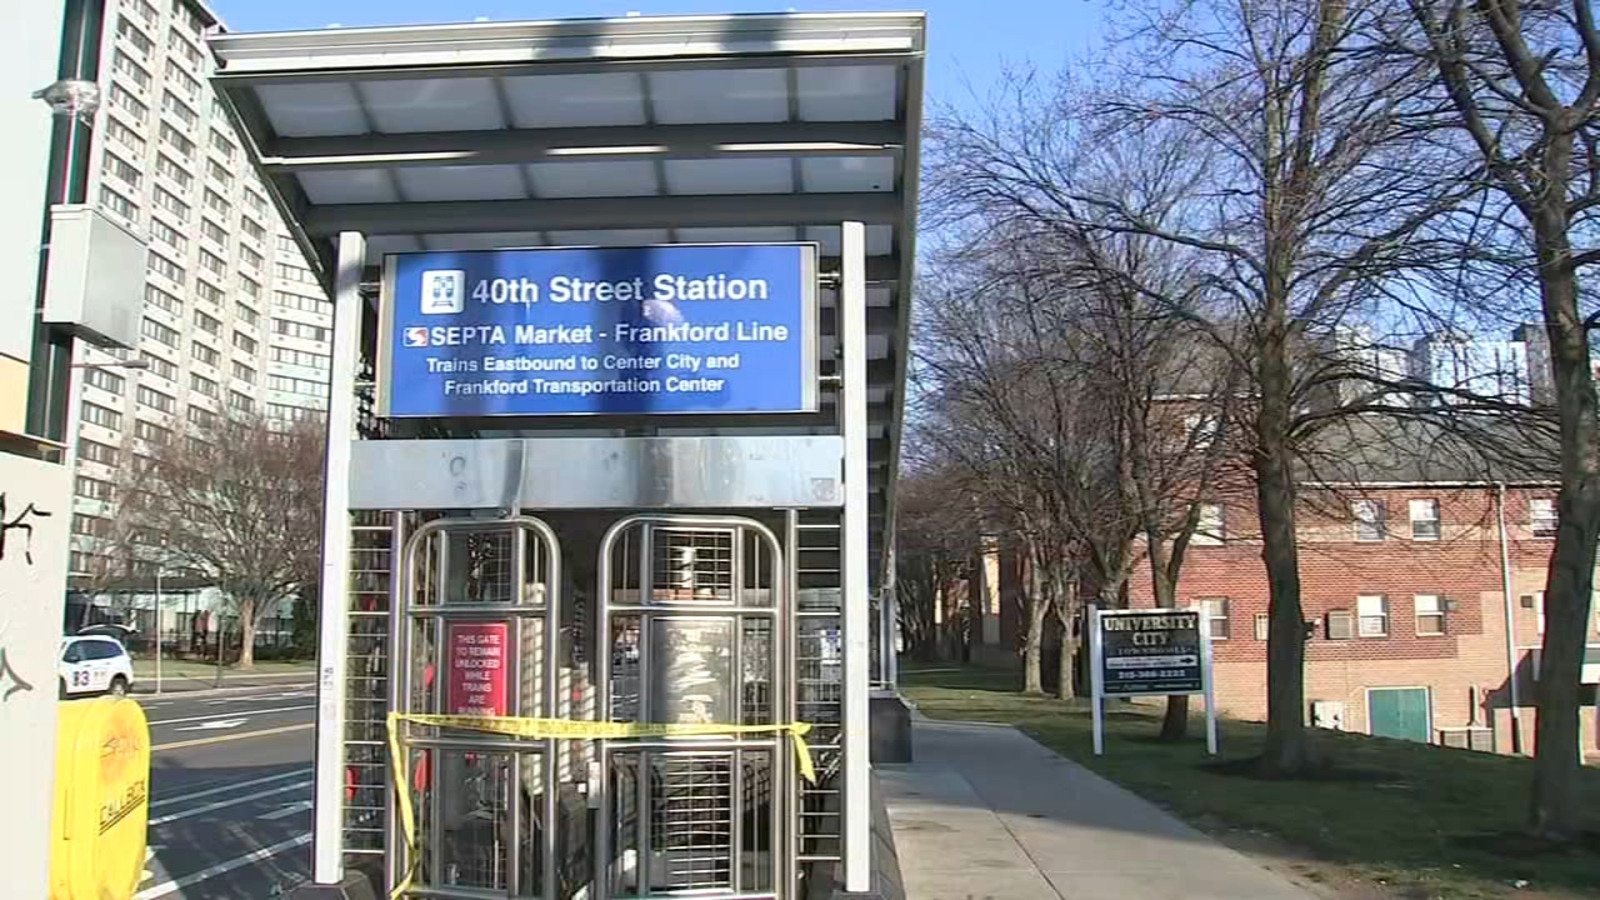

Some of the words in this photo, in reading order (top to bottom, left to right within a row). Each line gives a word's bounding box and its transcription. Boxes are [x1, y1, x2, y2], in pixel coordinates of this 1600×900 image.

[472, 277, 539, 304] 40th
[549, 276, 643, 302] Street
[653, 273, 768, 301] Station
[431, 325, 507, 346] SEPTA
[514, 324, 593, 344] Market
[615, 322, 730, 343] Frankford
[736, 321, 788, 341] Line
[426, 357, 478, 373] Trains
[484, 356, 576, 372] Eastbound
[581, 356, 598, 370] to
[603, 355, 661, 370] Center
[666, 353, 701, 373] City
[706, 353, 740, 369] and
[445, 379, 527, 395] Frankford
[533, 378, 660, 398] Transportation
[666, 376, 725, 392] Center
[1104, 616, 1196, 631] UNIVERSITY
[457, 635, 475, 644] THIS
[476, 634, 500, 644] GATE
[1133, 632, 1168, 645] CITY
[456, 647, 467, 656] TO
[469, 646, 501, 656] REMAIN
[455, 659, 501, 669] UNLOCKED
[464, 670, 491, 681] WHILE
[462, 683, 492, 692] TRAINS
[468, 695, 486, 705] ARE
